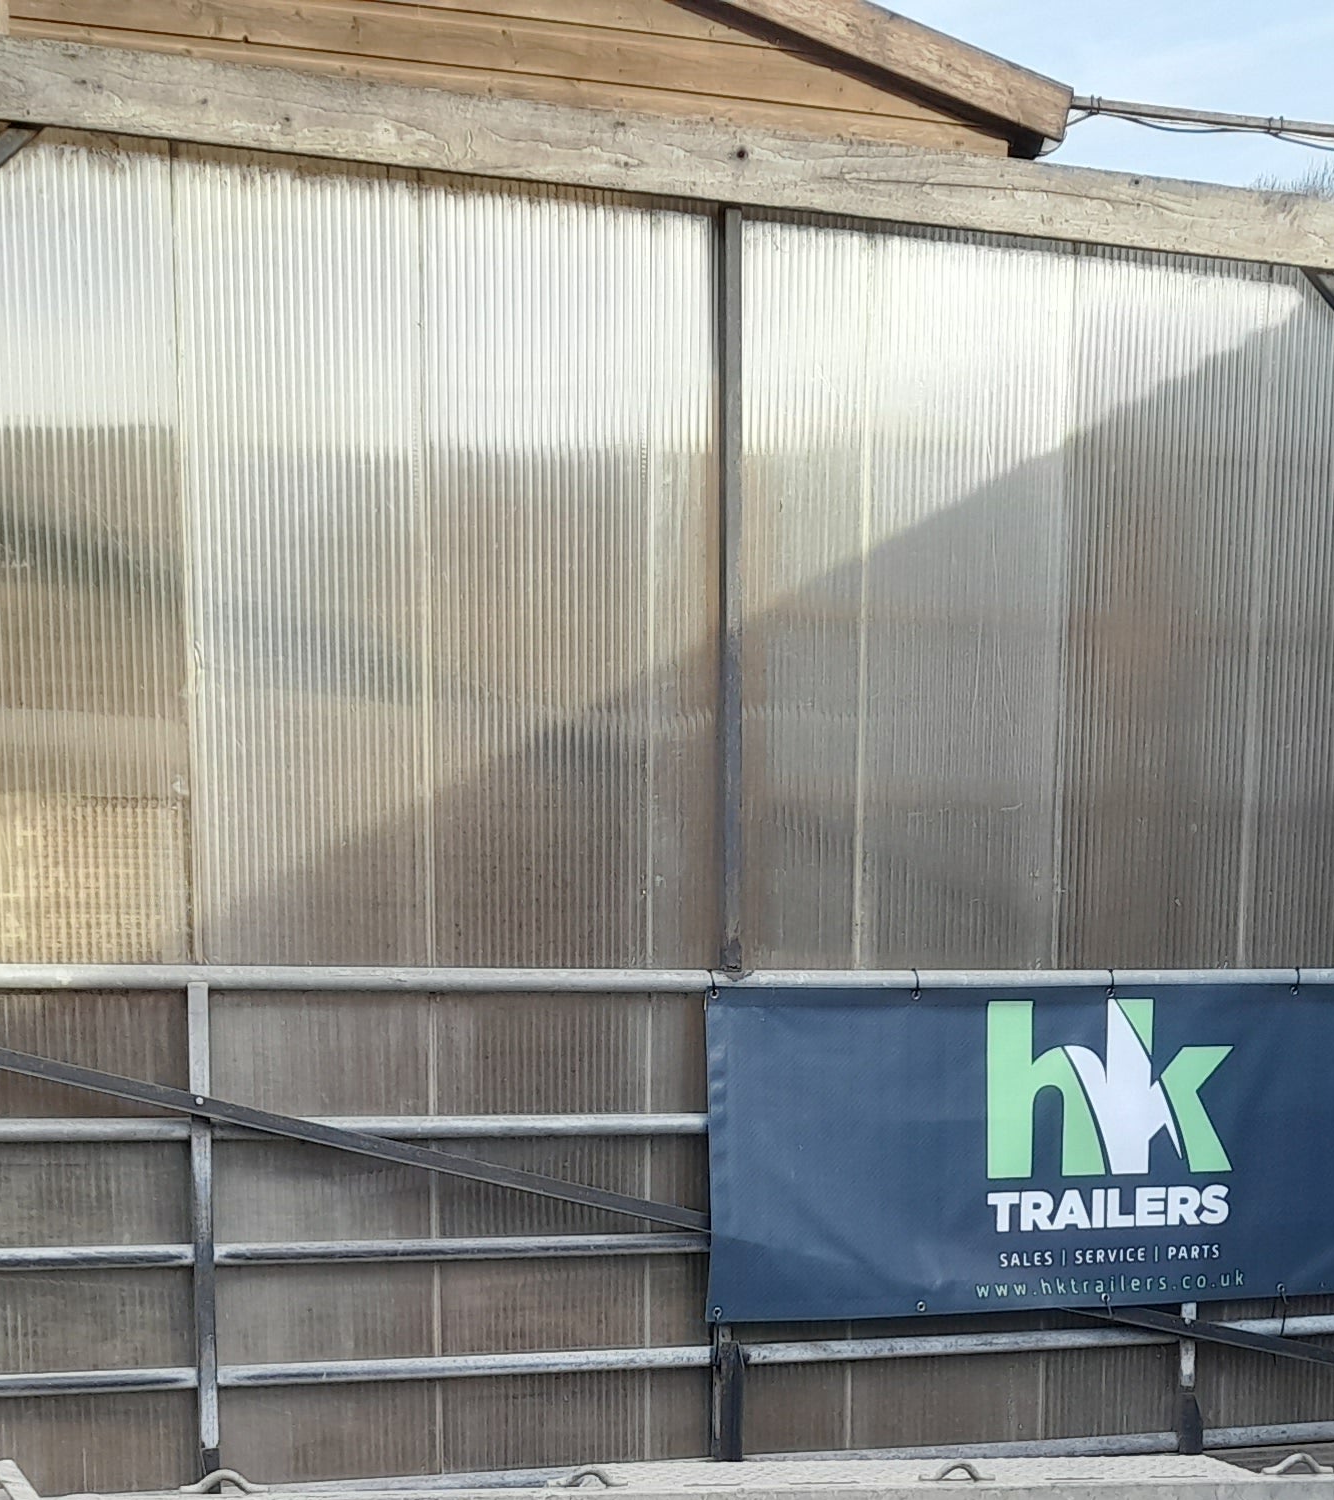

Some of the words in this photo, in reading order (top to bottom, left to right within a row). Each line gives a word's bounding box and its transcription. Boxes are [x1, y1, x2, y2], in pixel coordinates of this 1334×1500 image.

[986, 1184, 1231, 1234] TRAILERS
[999, 1250, 1054, 1268] SALES
[1074, 1247, 1147, 1264] SERVICE
[1167, 1244, 1220, 1261] PARTS
[976, 1269, 1245, 1299] www.hktrailers.co.uk
